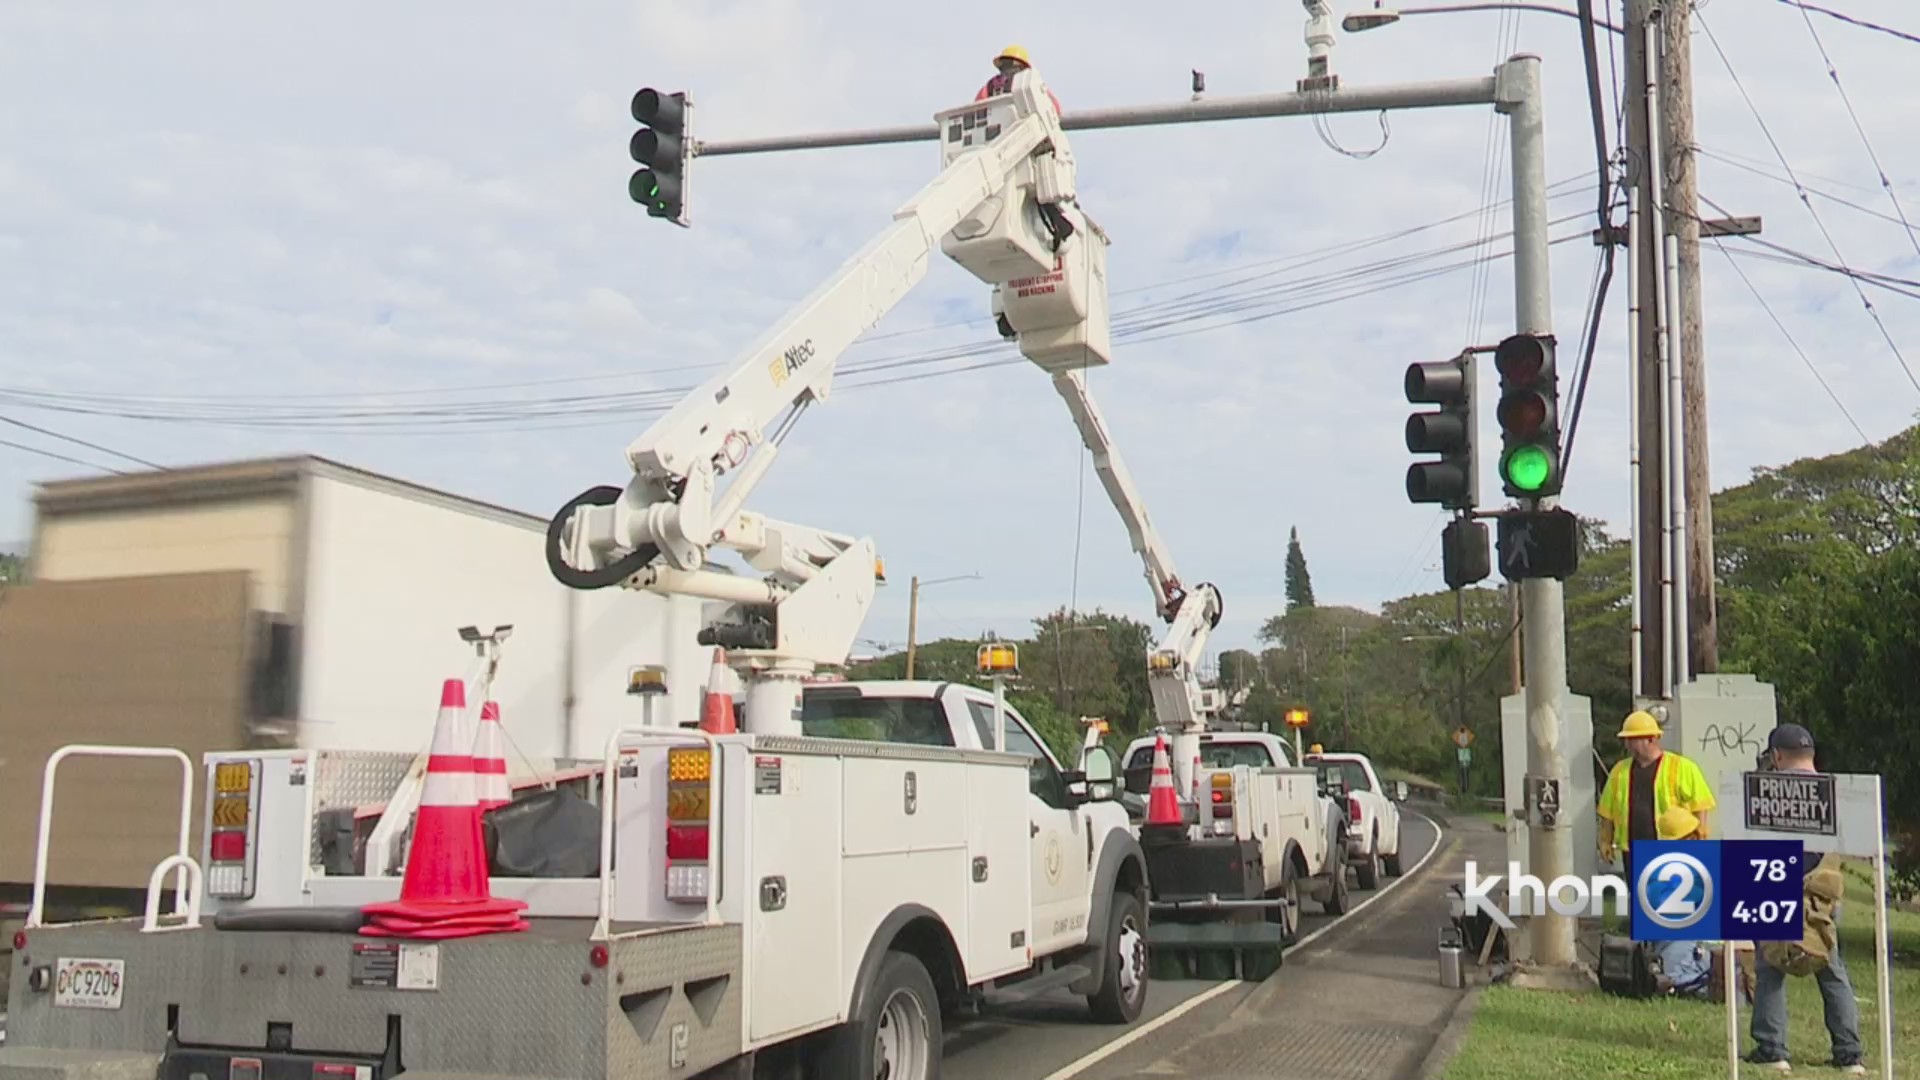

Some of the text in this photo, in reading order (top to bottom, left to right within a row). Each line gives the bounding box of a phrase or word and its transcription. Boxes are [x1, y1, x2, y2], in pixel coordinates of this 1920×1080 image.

[784, 338, 815, 376] Altec
[1760, 778, 1819, 800] PRIVATE
[1751, 797, 1828, 819] PROPERTY
